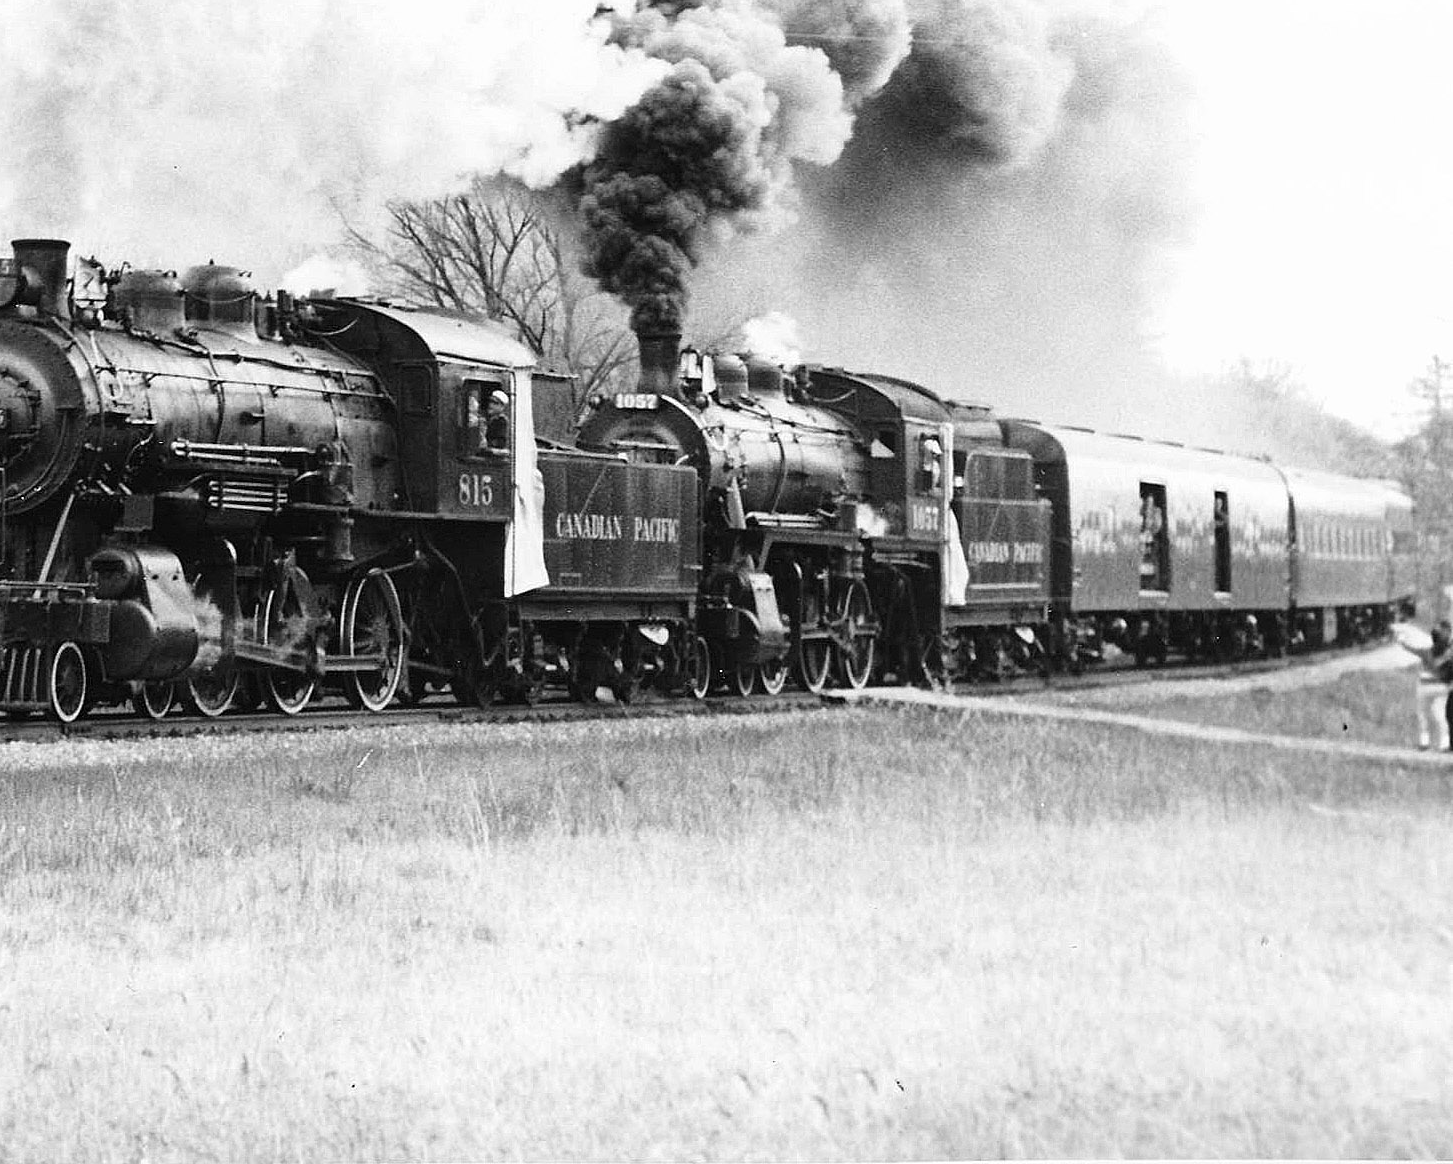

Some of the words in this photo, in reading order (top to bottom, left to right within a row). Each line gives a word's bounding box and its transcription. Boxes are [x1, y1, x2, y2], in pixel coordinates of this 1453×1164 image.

[616, 394, 657, 409] 1057
[459, 473, 493, 506] 815
[556, 512, 623, 540] CANADIAN
[633, 516, 680, 543] PACIFIC
